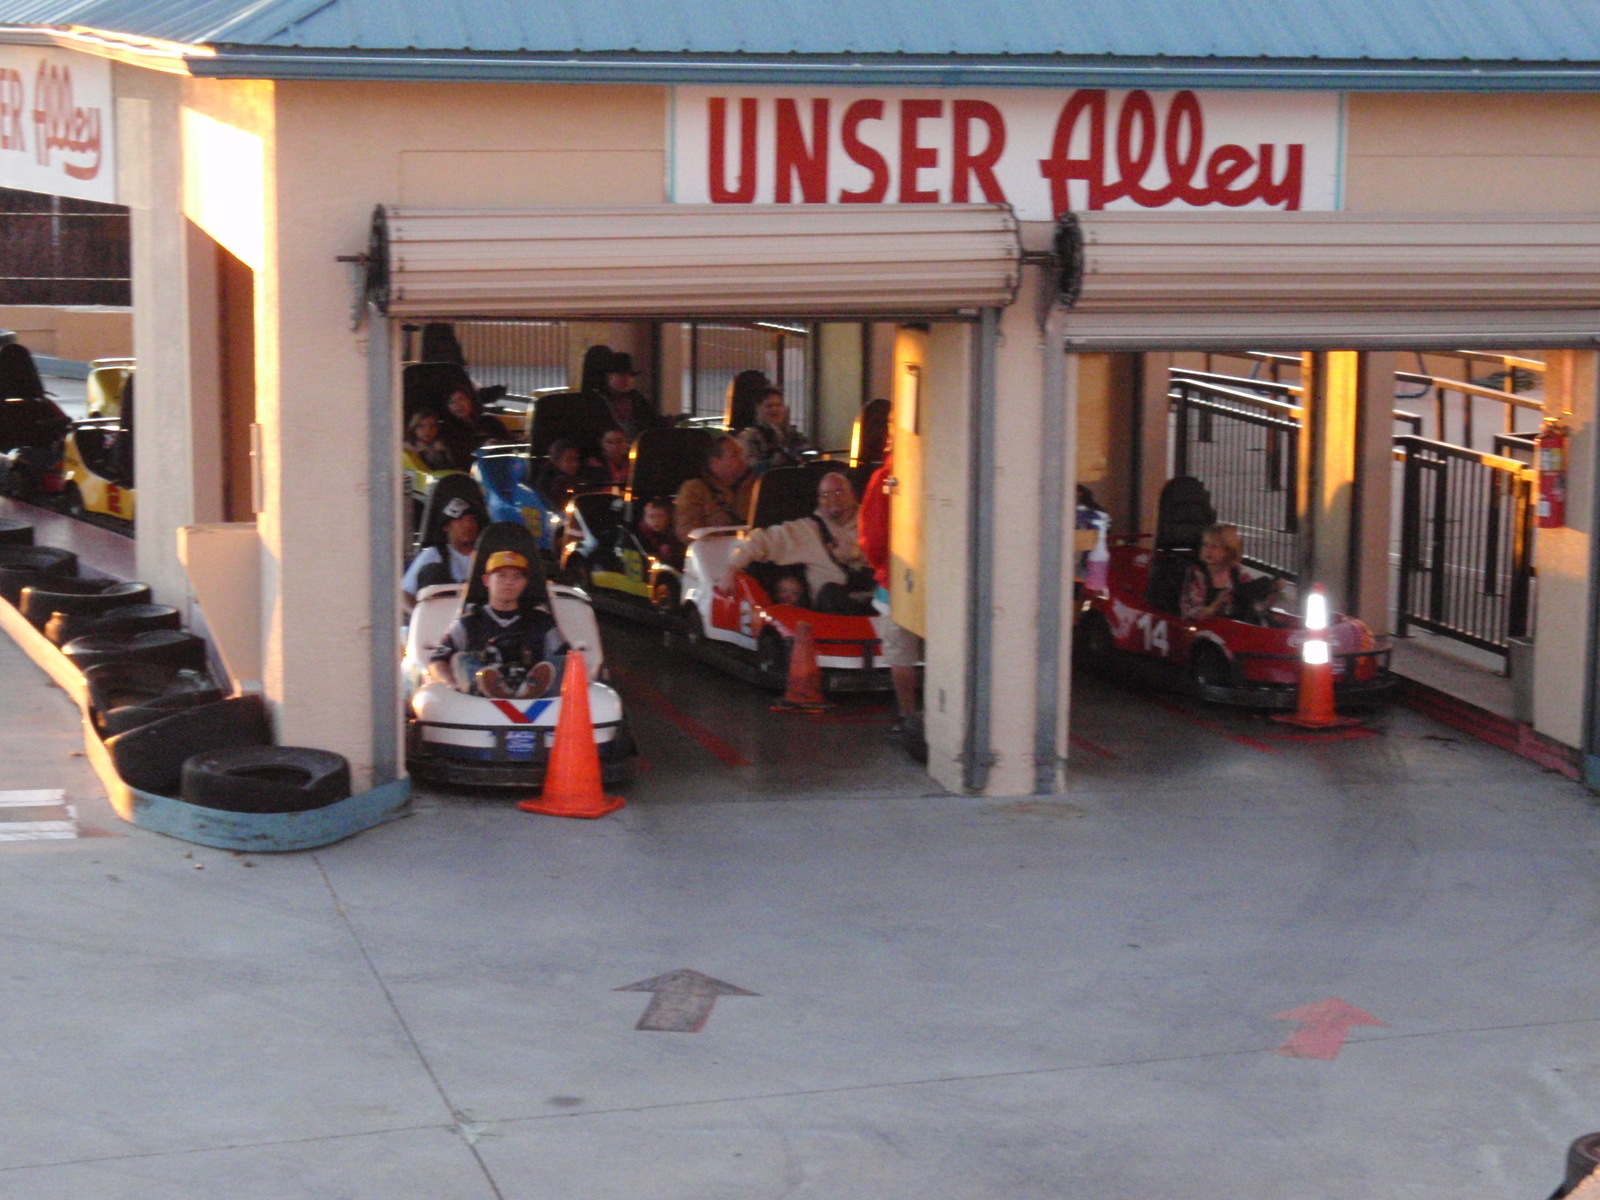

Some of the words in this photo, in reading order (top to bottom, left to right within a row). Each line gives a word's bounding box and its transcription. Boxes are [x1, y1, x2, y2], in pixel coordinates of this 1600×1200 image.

[33, 57, 102, 181] Alley
[707, 97, 1016, 205] UNSER
[1039, 88, 1305, 222] Alley
[1136, 613, 1170, 657] 14
